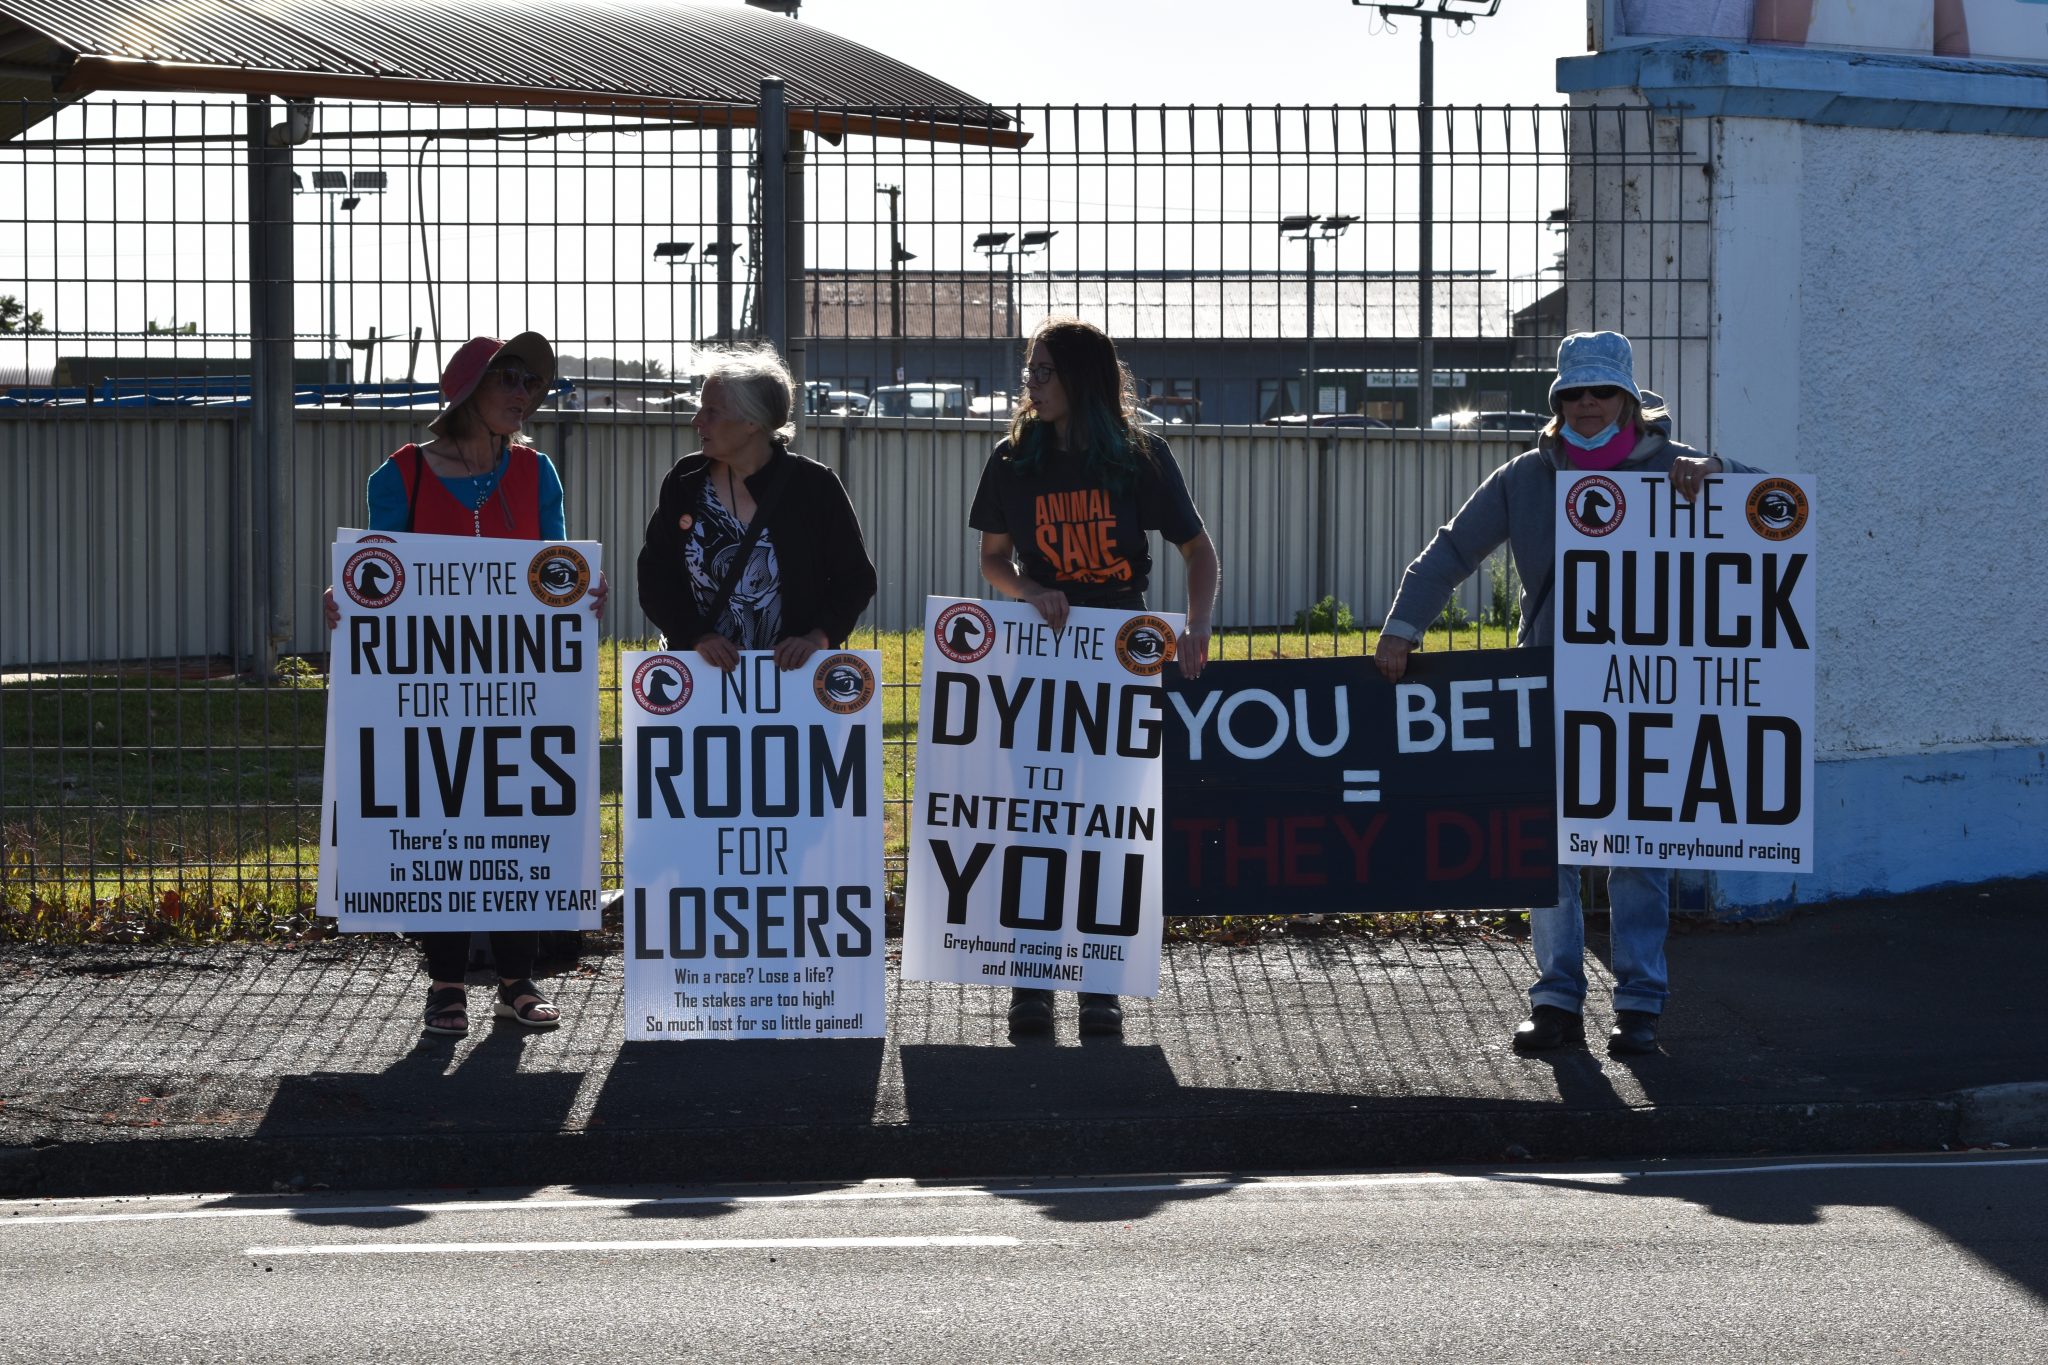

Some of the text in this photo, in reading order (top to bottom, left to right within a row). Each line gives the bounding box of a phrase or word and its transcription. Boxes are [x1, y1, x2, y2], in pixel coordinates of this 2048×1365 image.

[1036, 489, 1116, 526] ANIMAL
[1641, 477, 1724, 539] THE
[1036, 521, 1117, 573] SAVE
[413, 562, 516, 595] THEY'RE
[1563, 550, 1809, 649] QUICK
[351, 614, 582, 674] RUNNING
[1004, 621, 1105, 660] THEY'RE
[399, 682, 536, 717] FOR THEIR
[721, 656, 781, 714] NO
[1603, 655, 1761, 706] AND THE
[932, 671, 1163, 759] DYING
[1167, 675, 1547, 760] YOU BET
[360, 726, 576, 818] LIVES
[637, 725, 866, 818] ROOM
[1024, 766, 1063, 790] TO
[1563, 710, 1801, 825] DEAD
[927, 792, 1155, 841] ENTERTAIN
[390, 829, 550, 853] There's no money
[718, 827, 787, 875] FOR
[1171, 807, 1551, 887] THEY DIE
[1570, 833, 1800, 864] Say NO! To greyhound racing
[391, 860, 550, 882] in SLOW DOGS, so
[929, 839, 1144, 937] YOU
[345, 890, 596, 913] HUNDREDS DIE EVERY YEAR!
[635, 886, 871, 959] LOSERS
[944, 933, 1124, 961] Greyhound racing is CRUEL
[983, 961, 1083, 981] and INHUMANE!
[674, 991, 834, 1007] The stakes are too high!
[675, 967, 833, 984] Win a race? Lose a life?
[646, 1014, 862, 1033] So much lost for so little gained!
